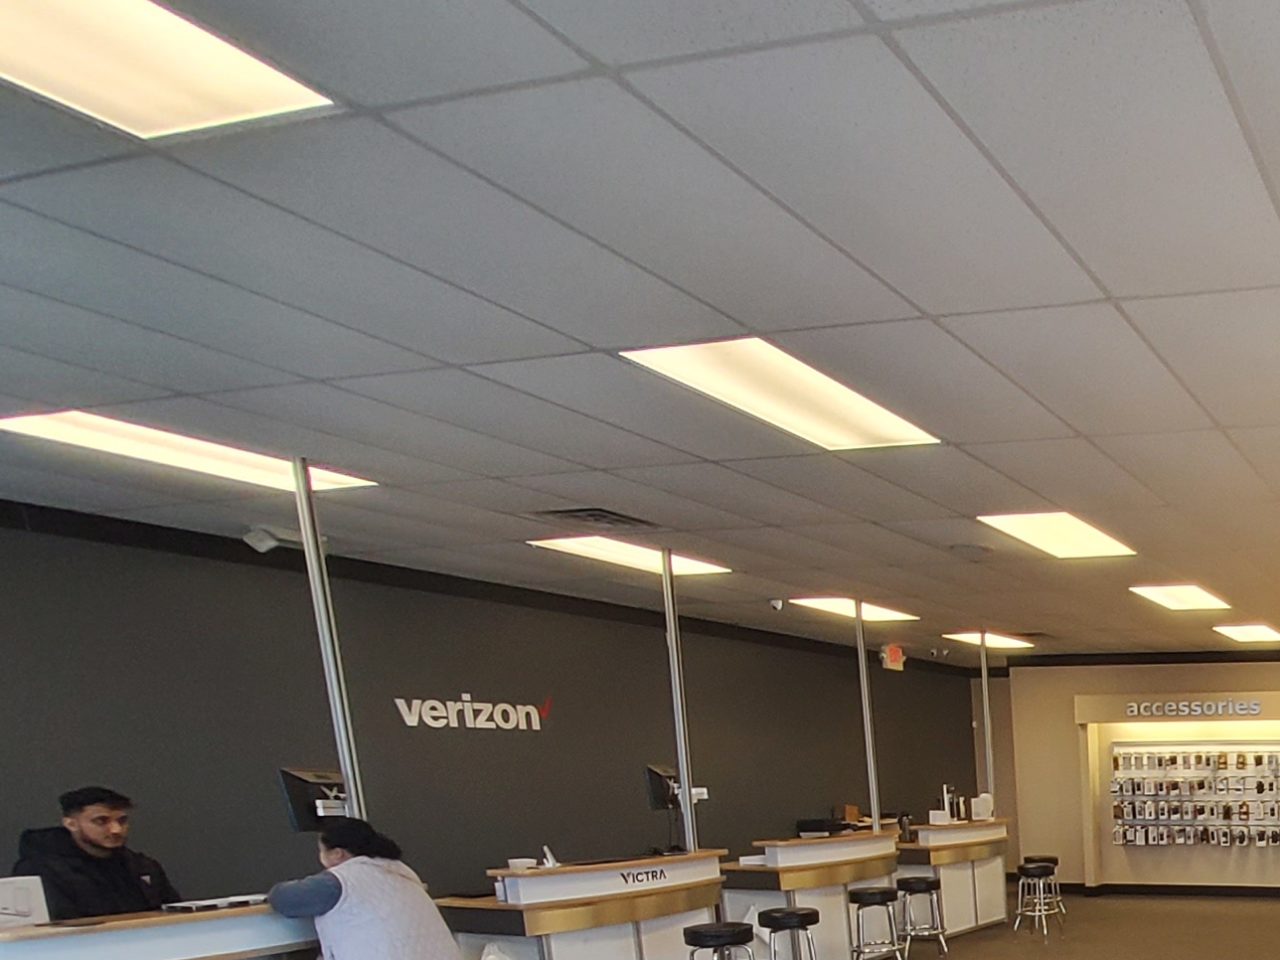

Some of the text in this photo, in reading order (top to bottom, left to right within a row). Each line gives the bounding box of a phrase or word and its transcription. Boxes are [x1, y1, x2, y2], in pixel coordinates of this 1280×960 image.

[394, 693, 541, 730] verizon
[1126, 698, 1262, 716] accessories
[620, 868, 667, 884] VICTRA
